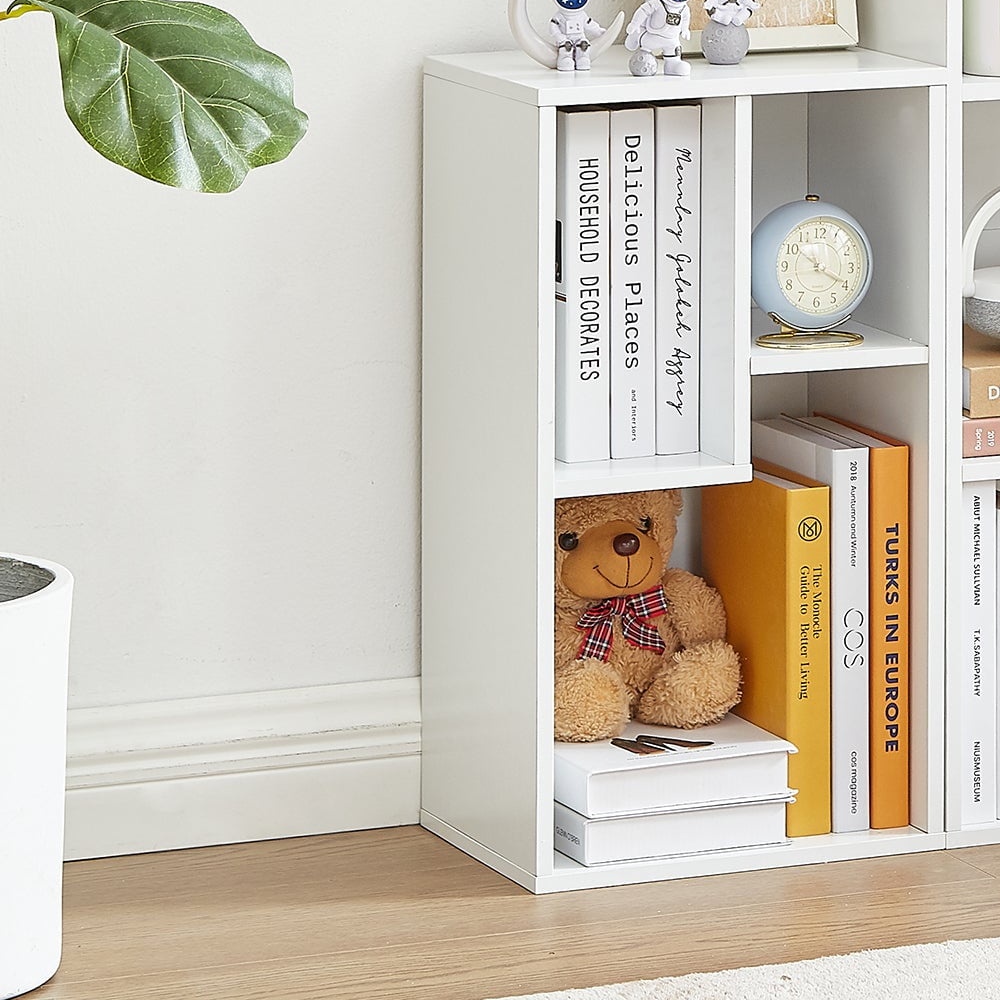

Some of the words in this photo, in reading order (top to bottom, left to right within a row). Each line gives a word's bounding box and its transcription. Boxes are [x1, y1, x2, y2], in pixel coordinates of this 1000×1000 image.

[579, 158, 600, 263] HOUSEHOLD
[624, 135, 643, 266] Delicious
[814, 228, 827, 239] 12
[786, 244, 799, 255] 10
[843, 245, 850, 256] 2
[781, 261, 788, 272] 9
[847, 262, 855, 274] 3
[785, 279, 793, 291] 8
[798, 291, 805, 302] 7
[841, 280, 849, 291] 4
[813, 297, 820, 308] 6
[830, 292, 837, 304] 5
[580, 276, 600, 381] DECORATES
[624, 282, 643, 369] Places
[975, 428, 983, 450] Spring
[987, 430, 995, 447] 2019
[973, 524, 981, 562] MICHAEL
[813, 564, 822, 588] The
[885, 523, 899, 605] TURKS
[800, 565, 810, 600] Guide
[800, 604, 808, 615] to
[813, 592, 822, 639] Monocle
[844, 608, 864, 669] COS
[885, 614, 899, 642] IN
[800, 624, 810, 658] Better
[798, 663, 810, 700] Living
[885, 653, 899, 752] EUROPE
